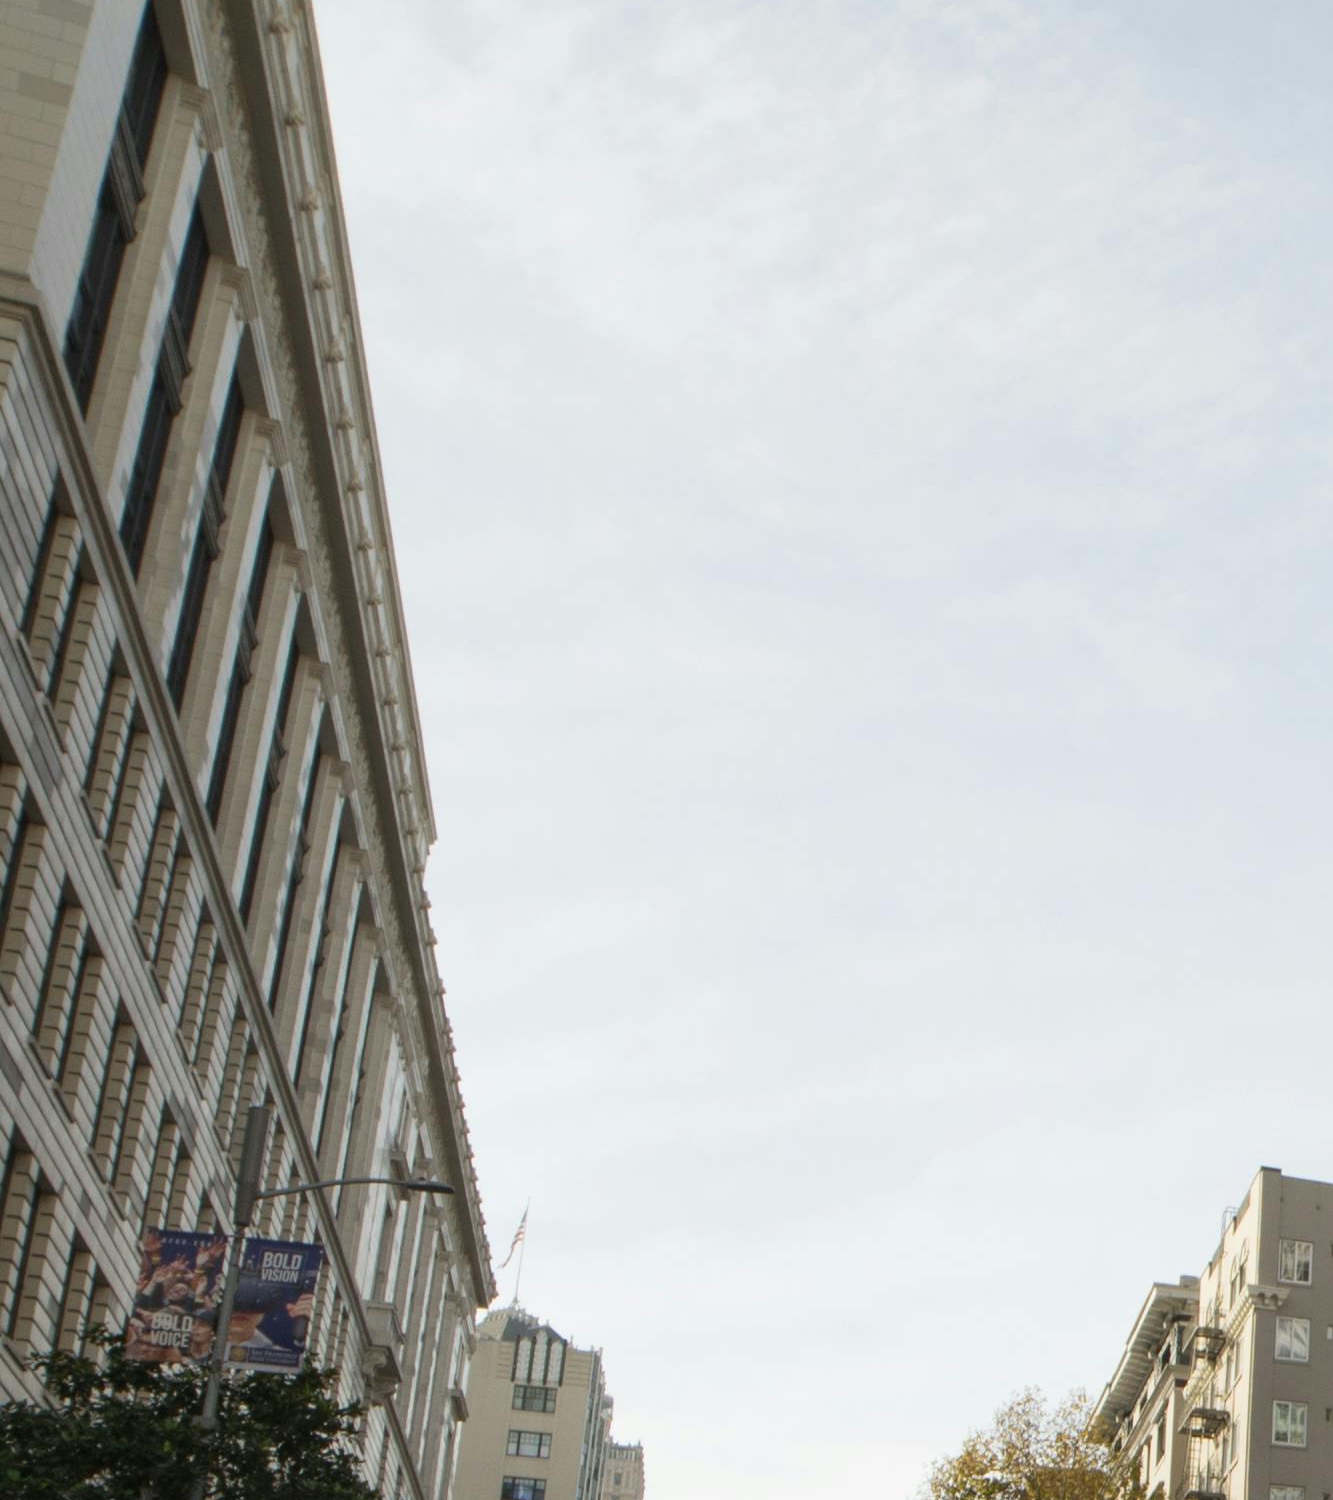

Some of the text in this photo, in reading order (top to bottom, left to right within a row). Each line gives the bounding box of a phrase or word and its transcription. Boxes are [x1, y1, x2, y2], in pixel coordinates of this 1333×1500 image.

[262, 1251, 303, 1270] BOLD
[260, 1267, 299, 1285] VISION
[151, 1313, 193, 1333] BOLD
[149, 1330, 190, 1349] VOICE
